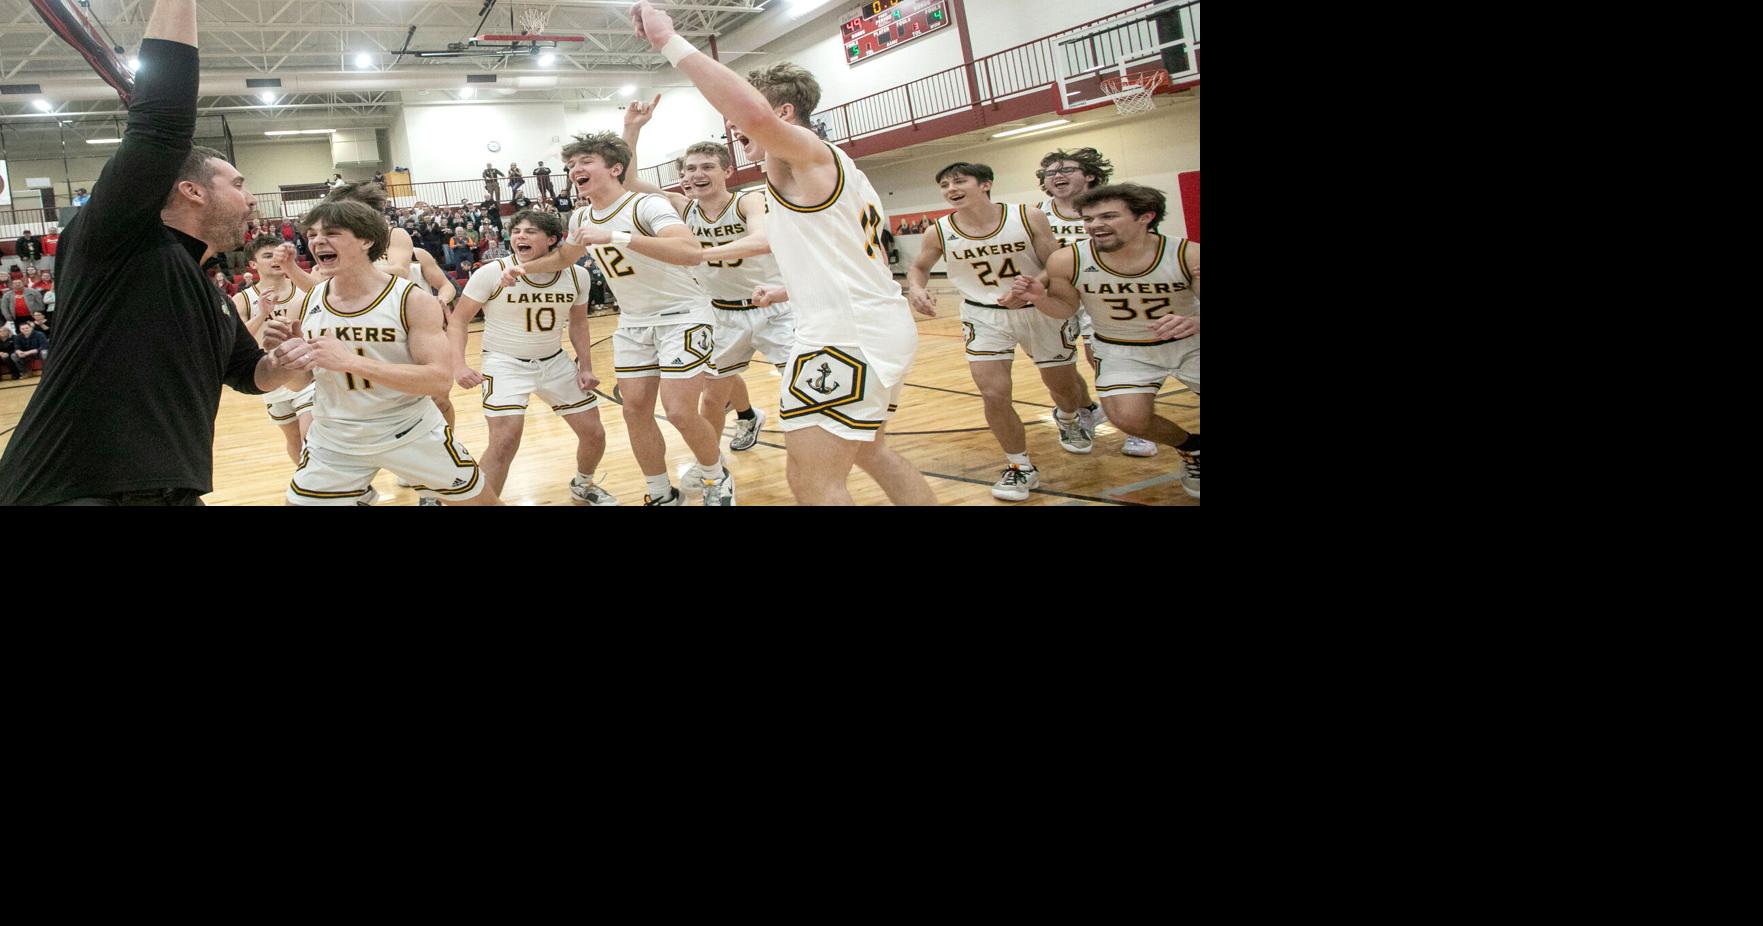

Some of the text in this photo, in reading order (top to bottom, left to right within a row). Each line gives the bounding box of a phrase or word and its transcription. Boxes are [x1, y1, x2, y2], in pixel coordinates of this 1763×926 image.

[934, 9, 942, 20] 4
[846, 17, 863, 32] 49
[913, 22, 919, 31] 3
[852, 45, 860, 57] 5
[952, 241, 1026, 260] LAKERS
[594, 246, 636, 278] 12
[971, 258, 1021, 287] 24
[1083, 282, 1188, 294] LAKERS
[507, 293, 574, 304] LAKERS
[1103, 297, 1174, 321] 32
[525, 307, 556, 333] 10
